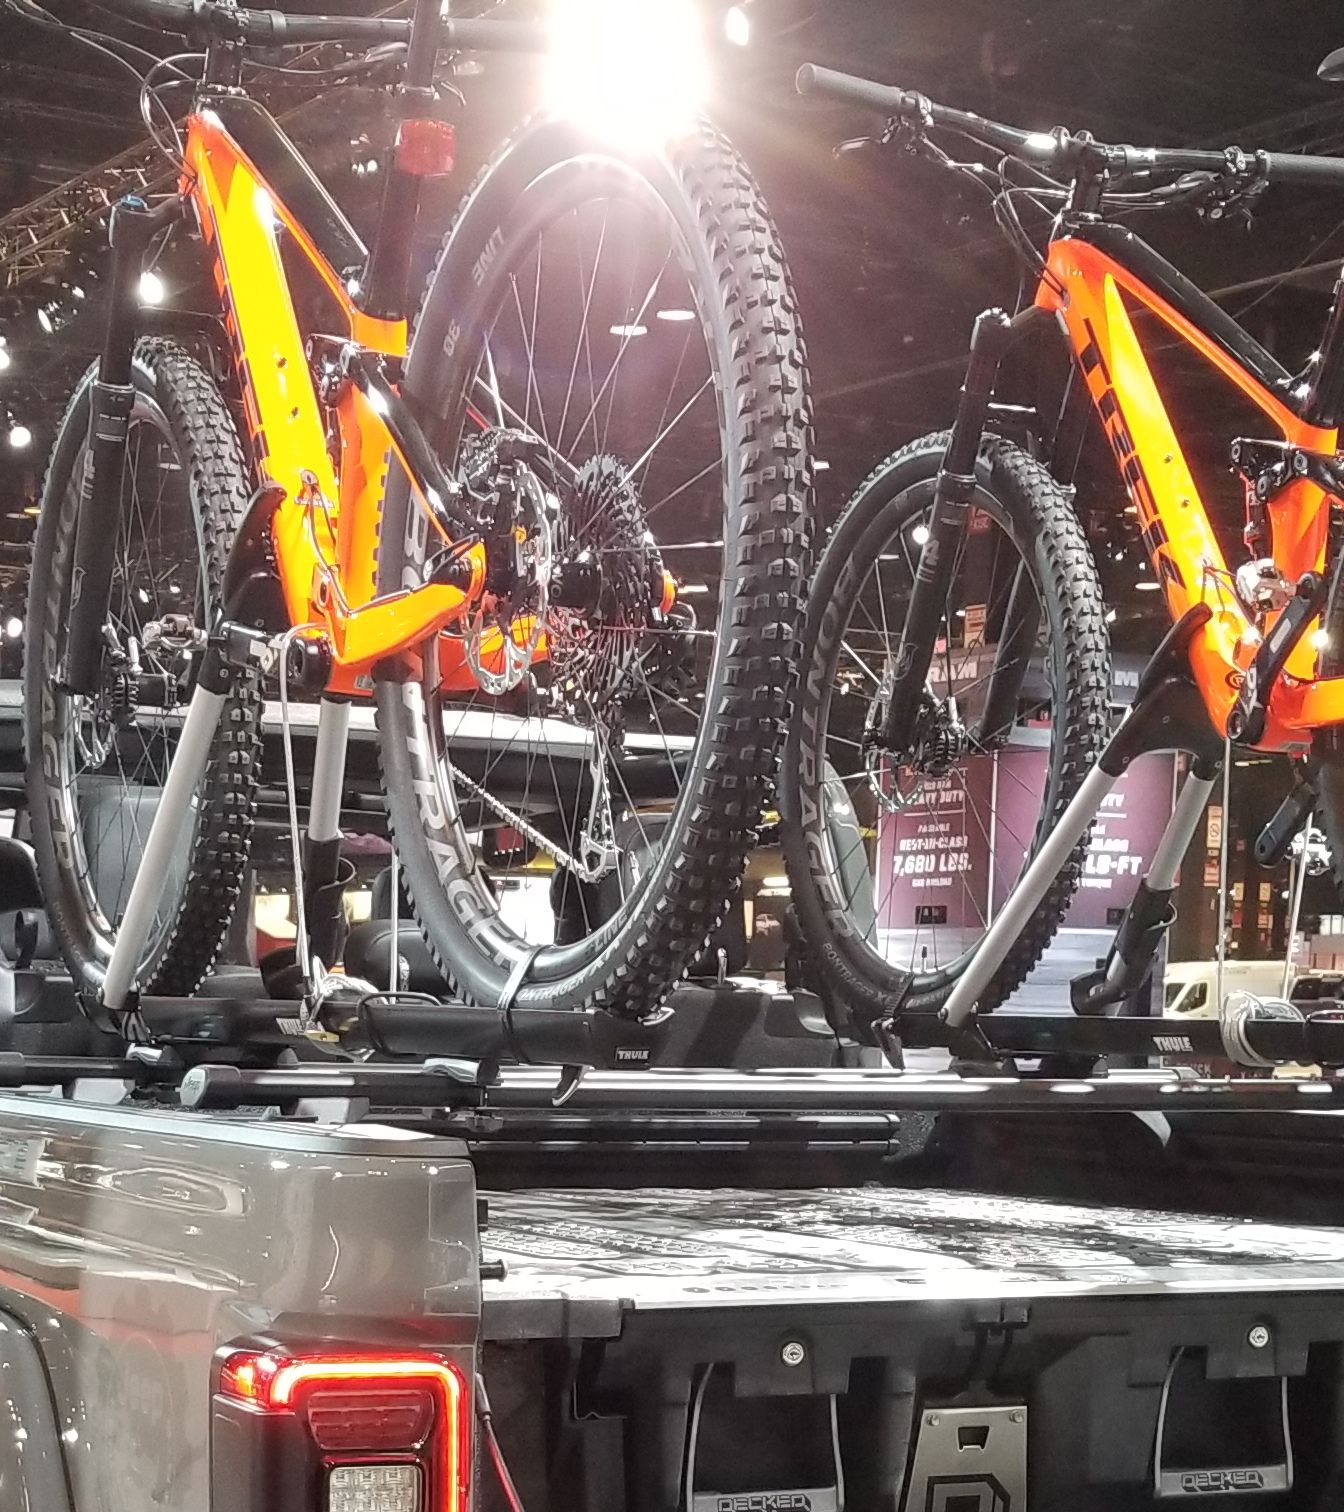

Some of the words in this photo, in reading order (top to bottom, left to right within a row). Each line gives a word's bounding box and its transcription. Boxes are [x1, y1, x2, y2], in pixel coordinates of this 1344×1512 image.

[471, 225, 505, 287] LINE
[515, 974, 585, 999] ONTRAGER
[618, 1050, 649, 1060] THULE
[1152, 1036, 1193, 1051] THULE
[1181, 1470, 1265, 1493] DECKED
